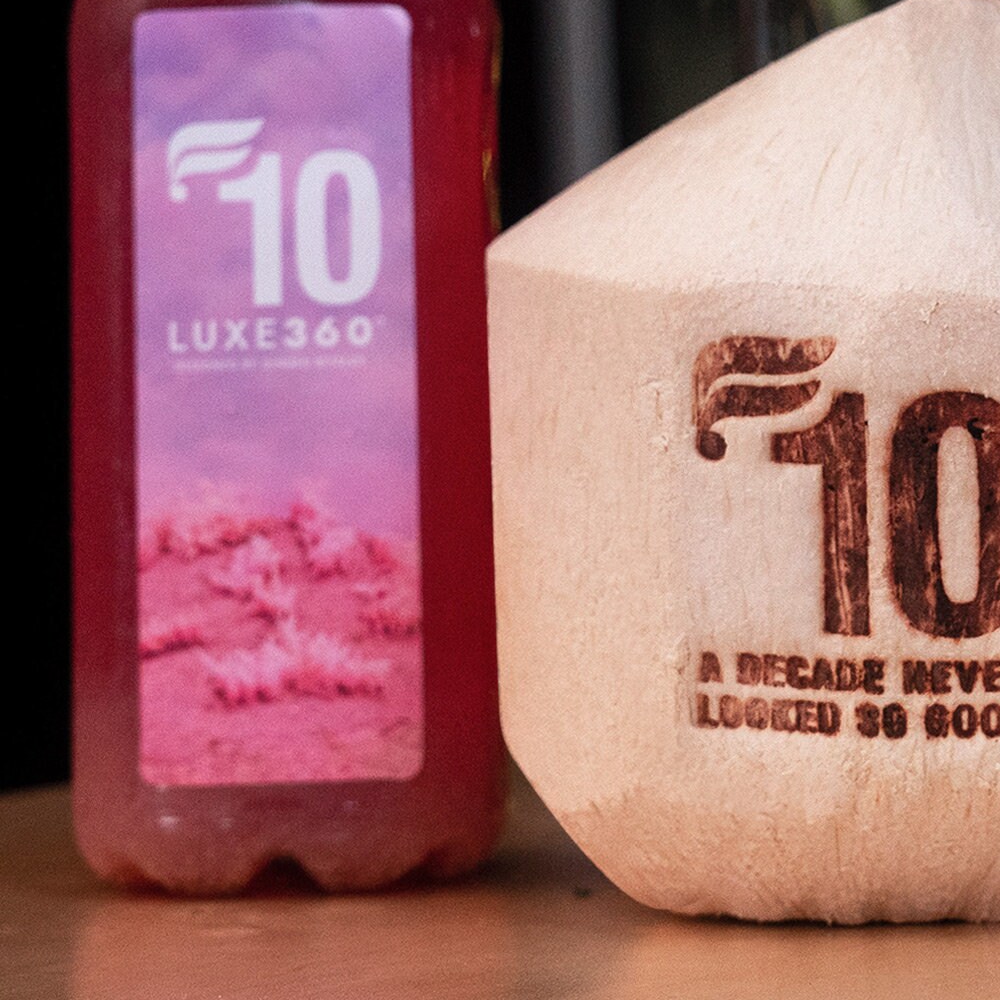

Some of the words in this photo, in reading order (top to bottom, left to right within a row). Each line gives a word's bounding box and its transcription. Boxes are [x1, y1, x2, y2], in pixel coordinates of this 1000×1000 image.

[167, 315, 373, 352] LUXE360
[699, 652, 723, 683] A
[737, 652, 886, 695] DECADE
[696, 694, 841, 736] LOOKED
[855, 702, 908, 739] SO
